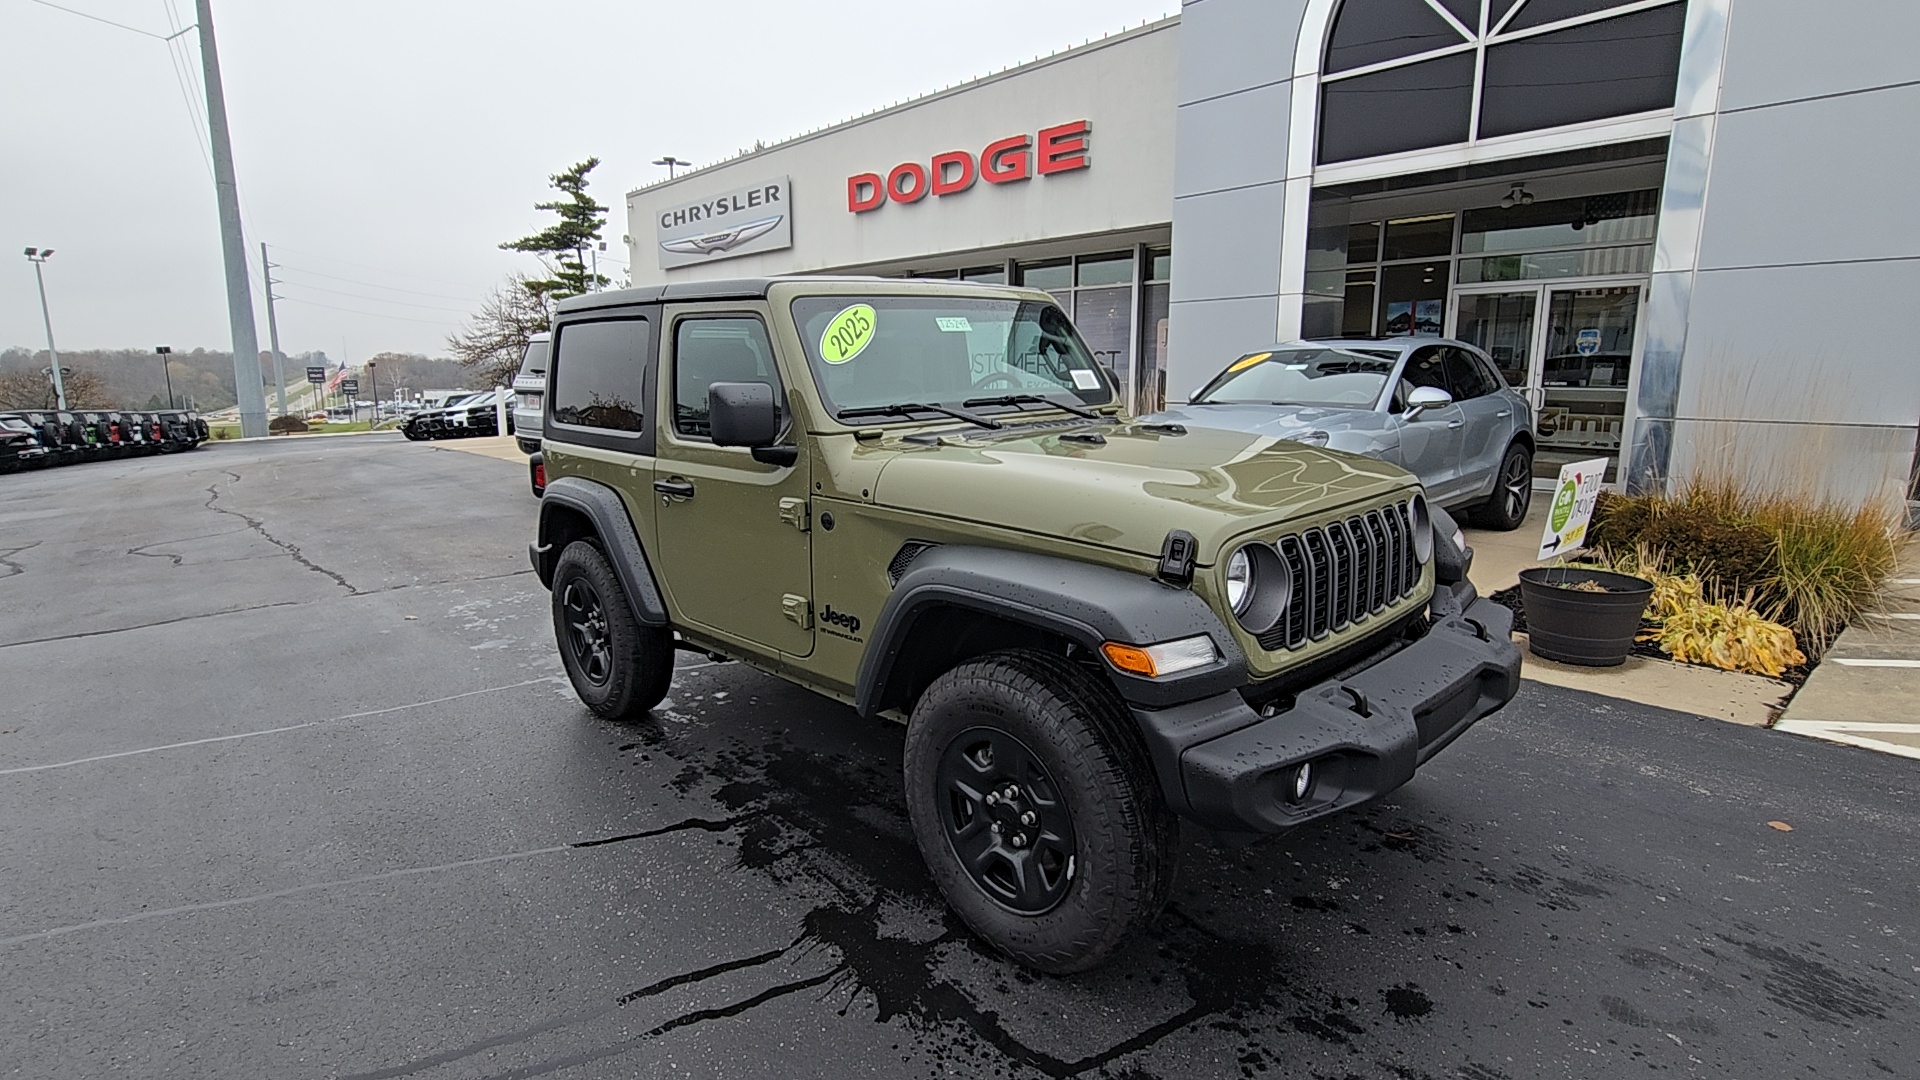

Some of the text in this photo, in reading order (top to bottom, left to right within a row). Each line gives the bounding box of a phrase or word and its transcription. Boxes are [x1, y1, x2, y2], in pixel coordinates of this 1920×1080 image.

[848, 120, 1092, 213] DODGE
[660, 184, 781, 230] CHRYSLER
[830, 309, 871, 358] 2025
[819, 604, 861, 634] Jeep
